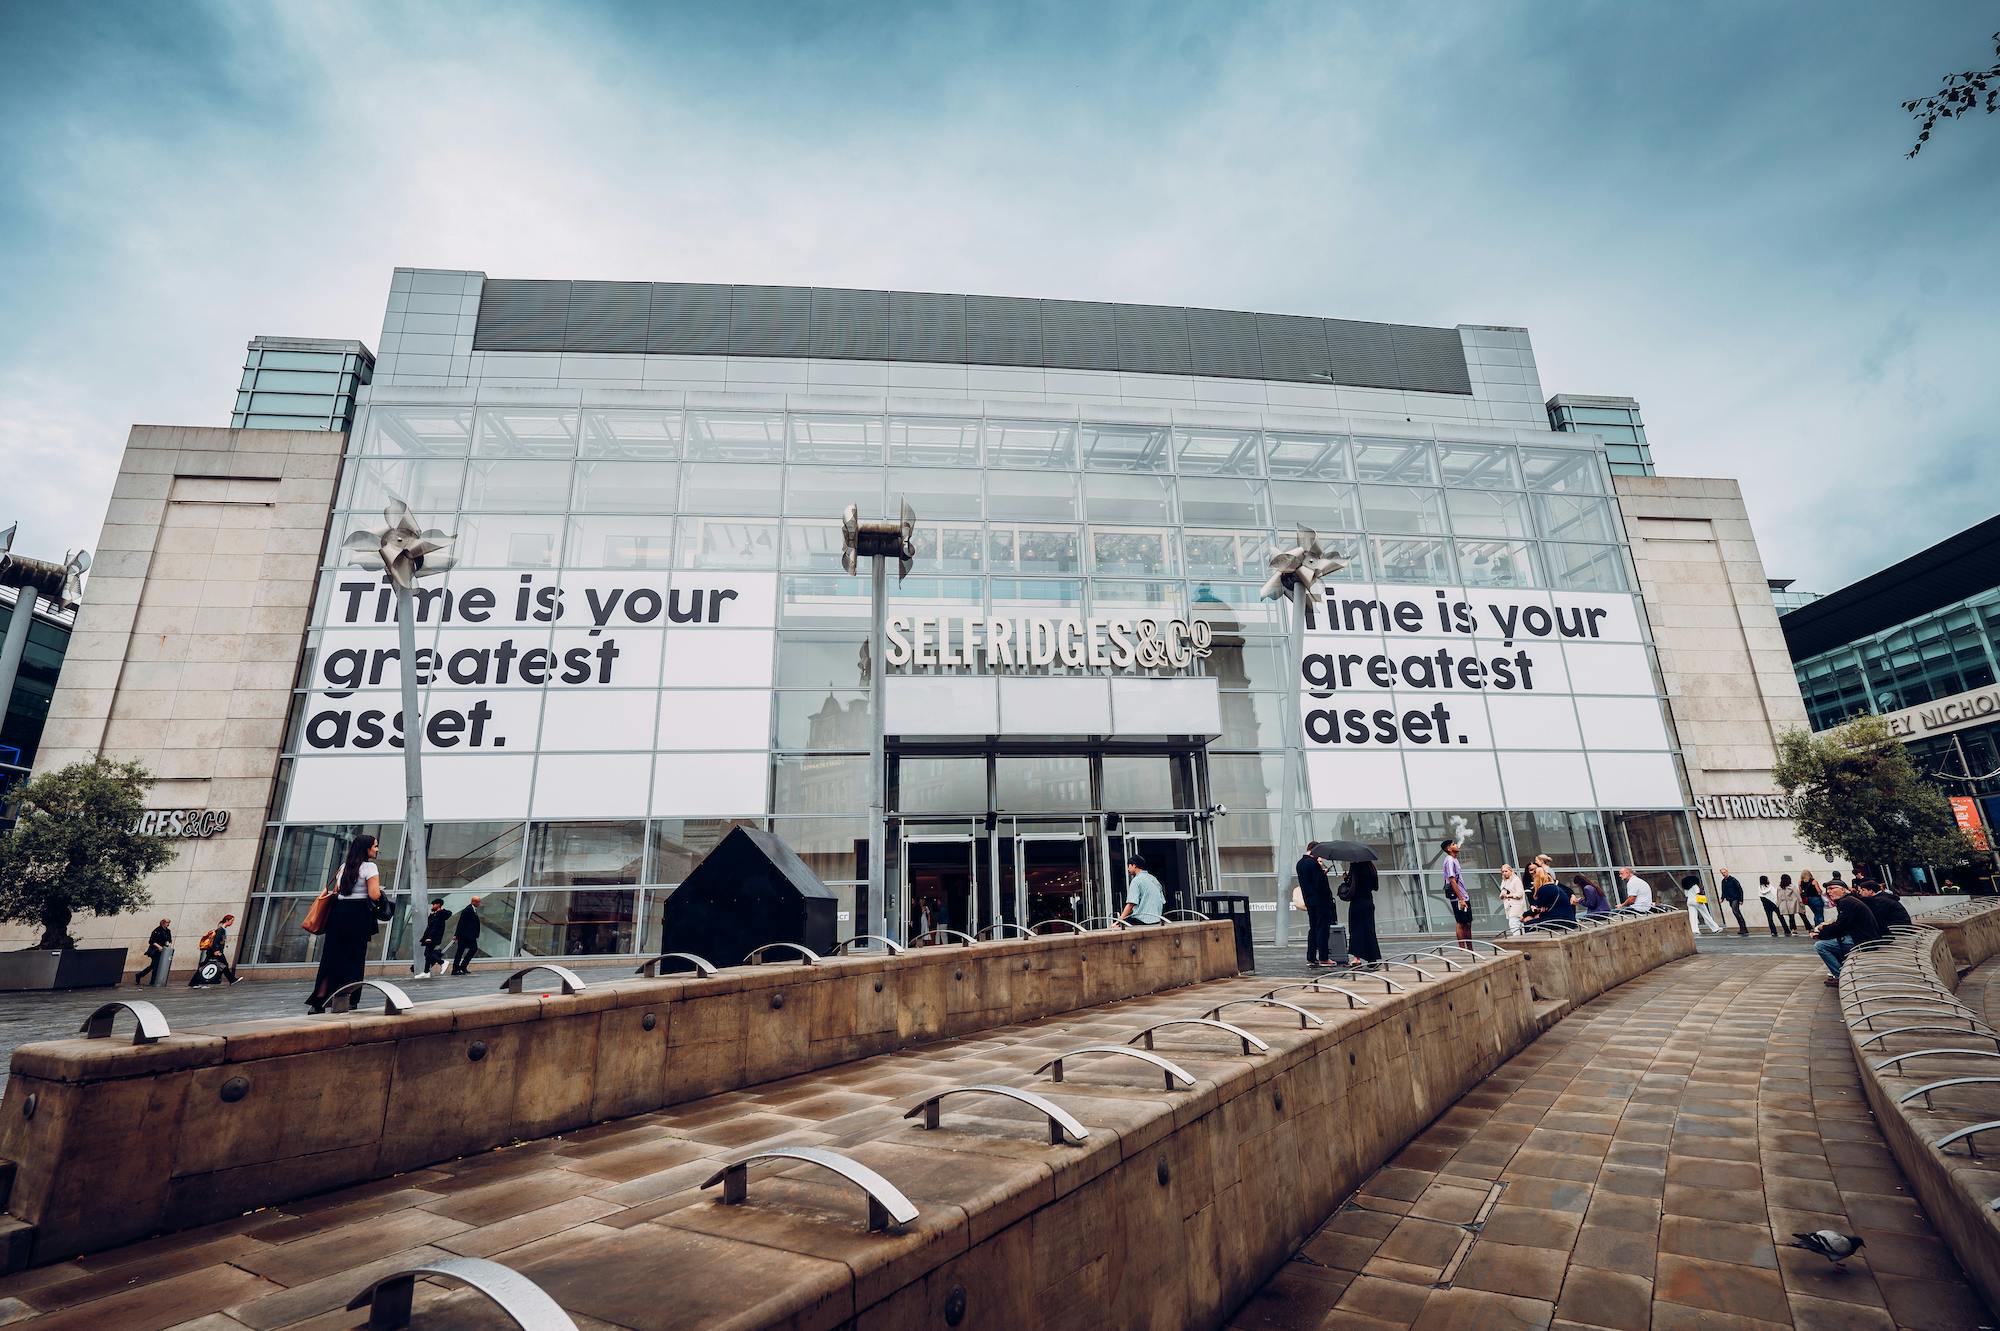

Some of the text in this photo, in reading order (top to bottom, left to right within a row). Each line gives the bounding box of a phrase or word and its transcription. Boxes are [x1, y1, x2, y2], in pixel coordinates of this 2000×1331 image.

[339, 574, 739, 637] Time is your
[1435, 590, 1478, 634] is
[1488, 604, 1607, 648] your
[323, 638, 620, 699] greatest
[1301, 648, 1533, 699] greatest
[1304, 702, 1469, 744] asset.
